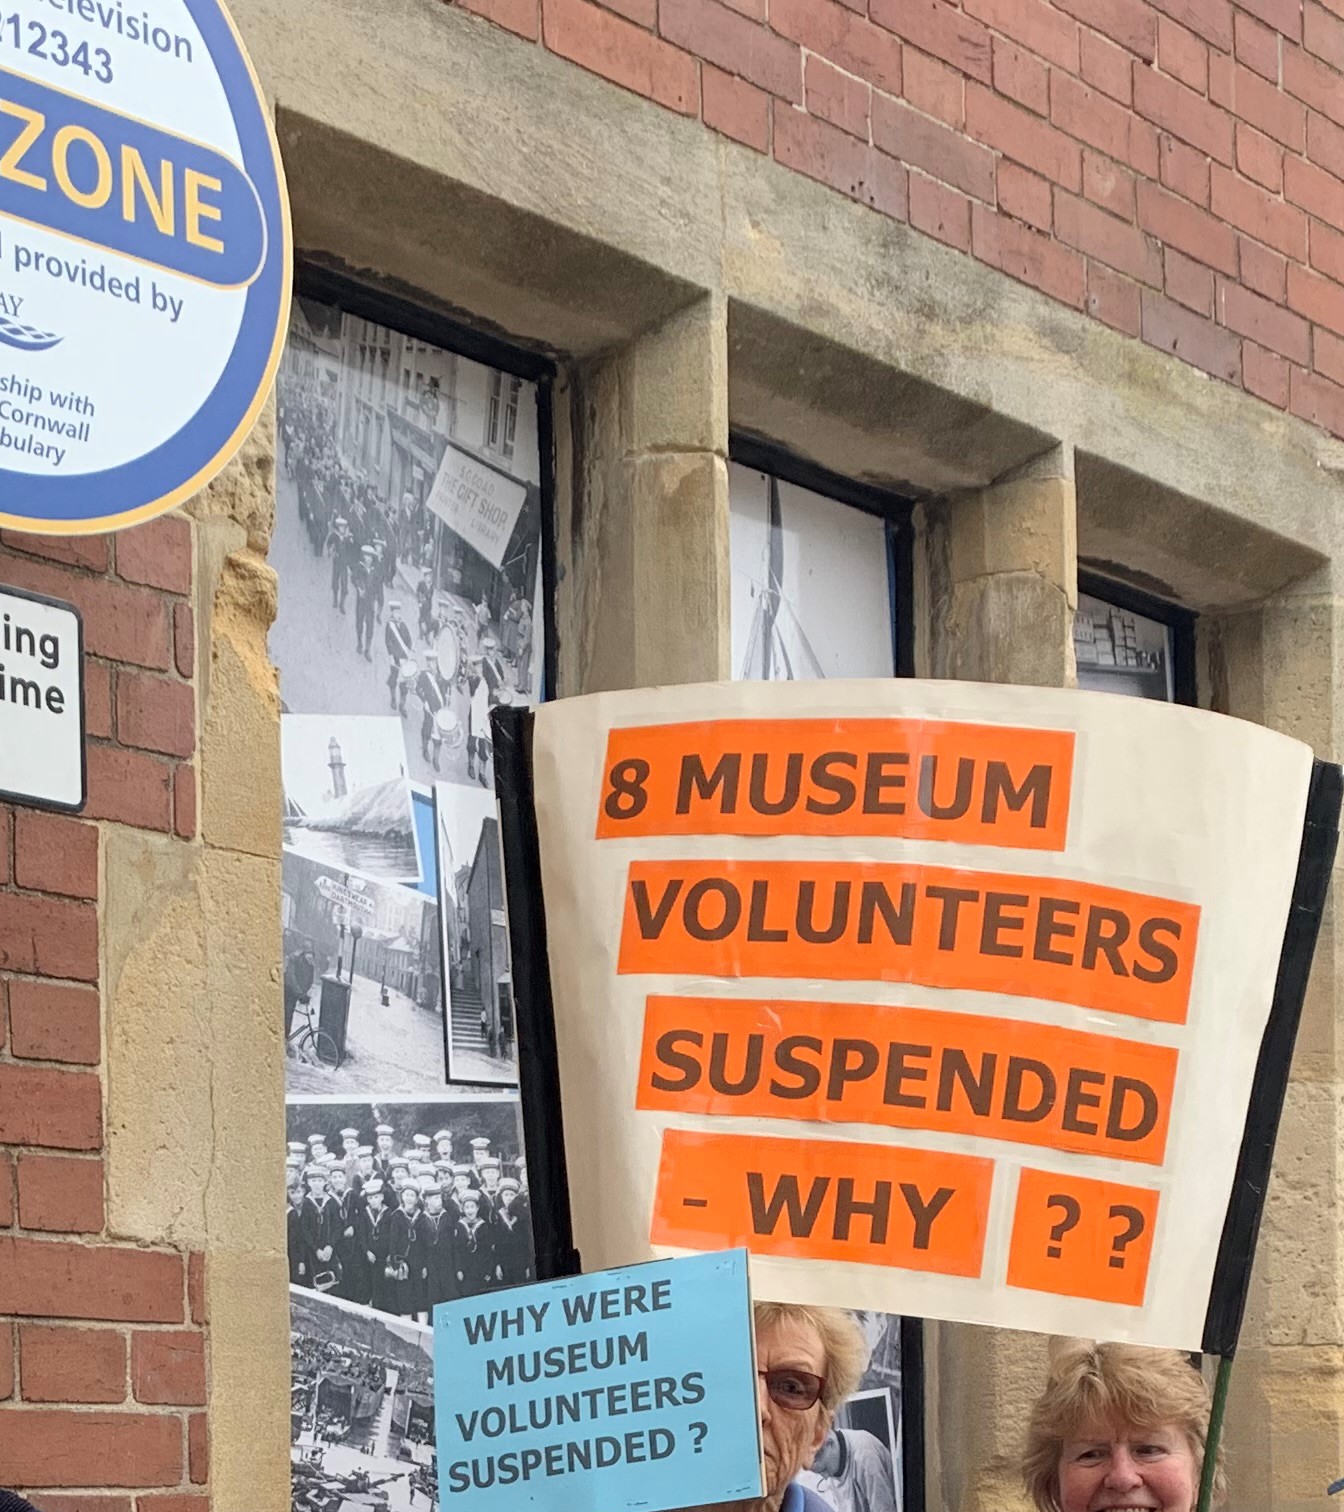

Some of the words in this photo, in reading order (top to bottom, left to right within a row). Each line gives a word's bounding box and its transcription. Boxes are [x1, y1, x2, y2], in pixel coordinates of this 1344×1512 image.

[14, 243, 140, 304] provided
[152, 281, 184, 322] by
[49, 391, 95, 417] with
[457, 483, 479, 509] GIFT
[603, 759, 650, 820] 8
[674, 752, 1054, 830] MUSEUM
[631, 878, 1182, 984] VOLUNTEERS
[650, 1030, 1160, 1142] SUSPENDED
[746, 1171, 955, 1250] WHY
[463, 1301, 550, 1345] WHY
[562, 1279, 672, 1327] WERE
[486, 1331, 649, 1390] MUSEUM
[455, 1371, 706, 1442] VOLUNTEERS
[449, 1427, 675, 1493] SUSPENDED
[688, 1422, 709, 1454] ?
